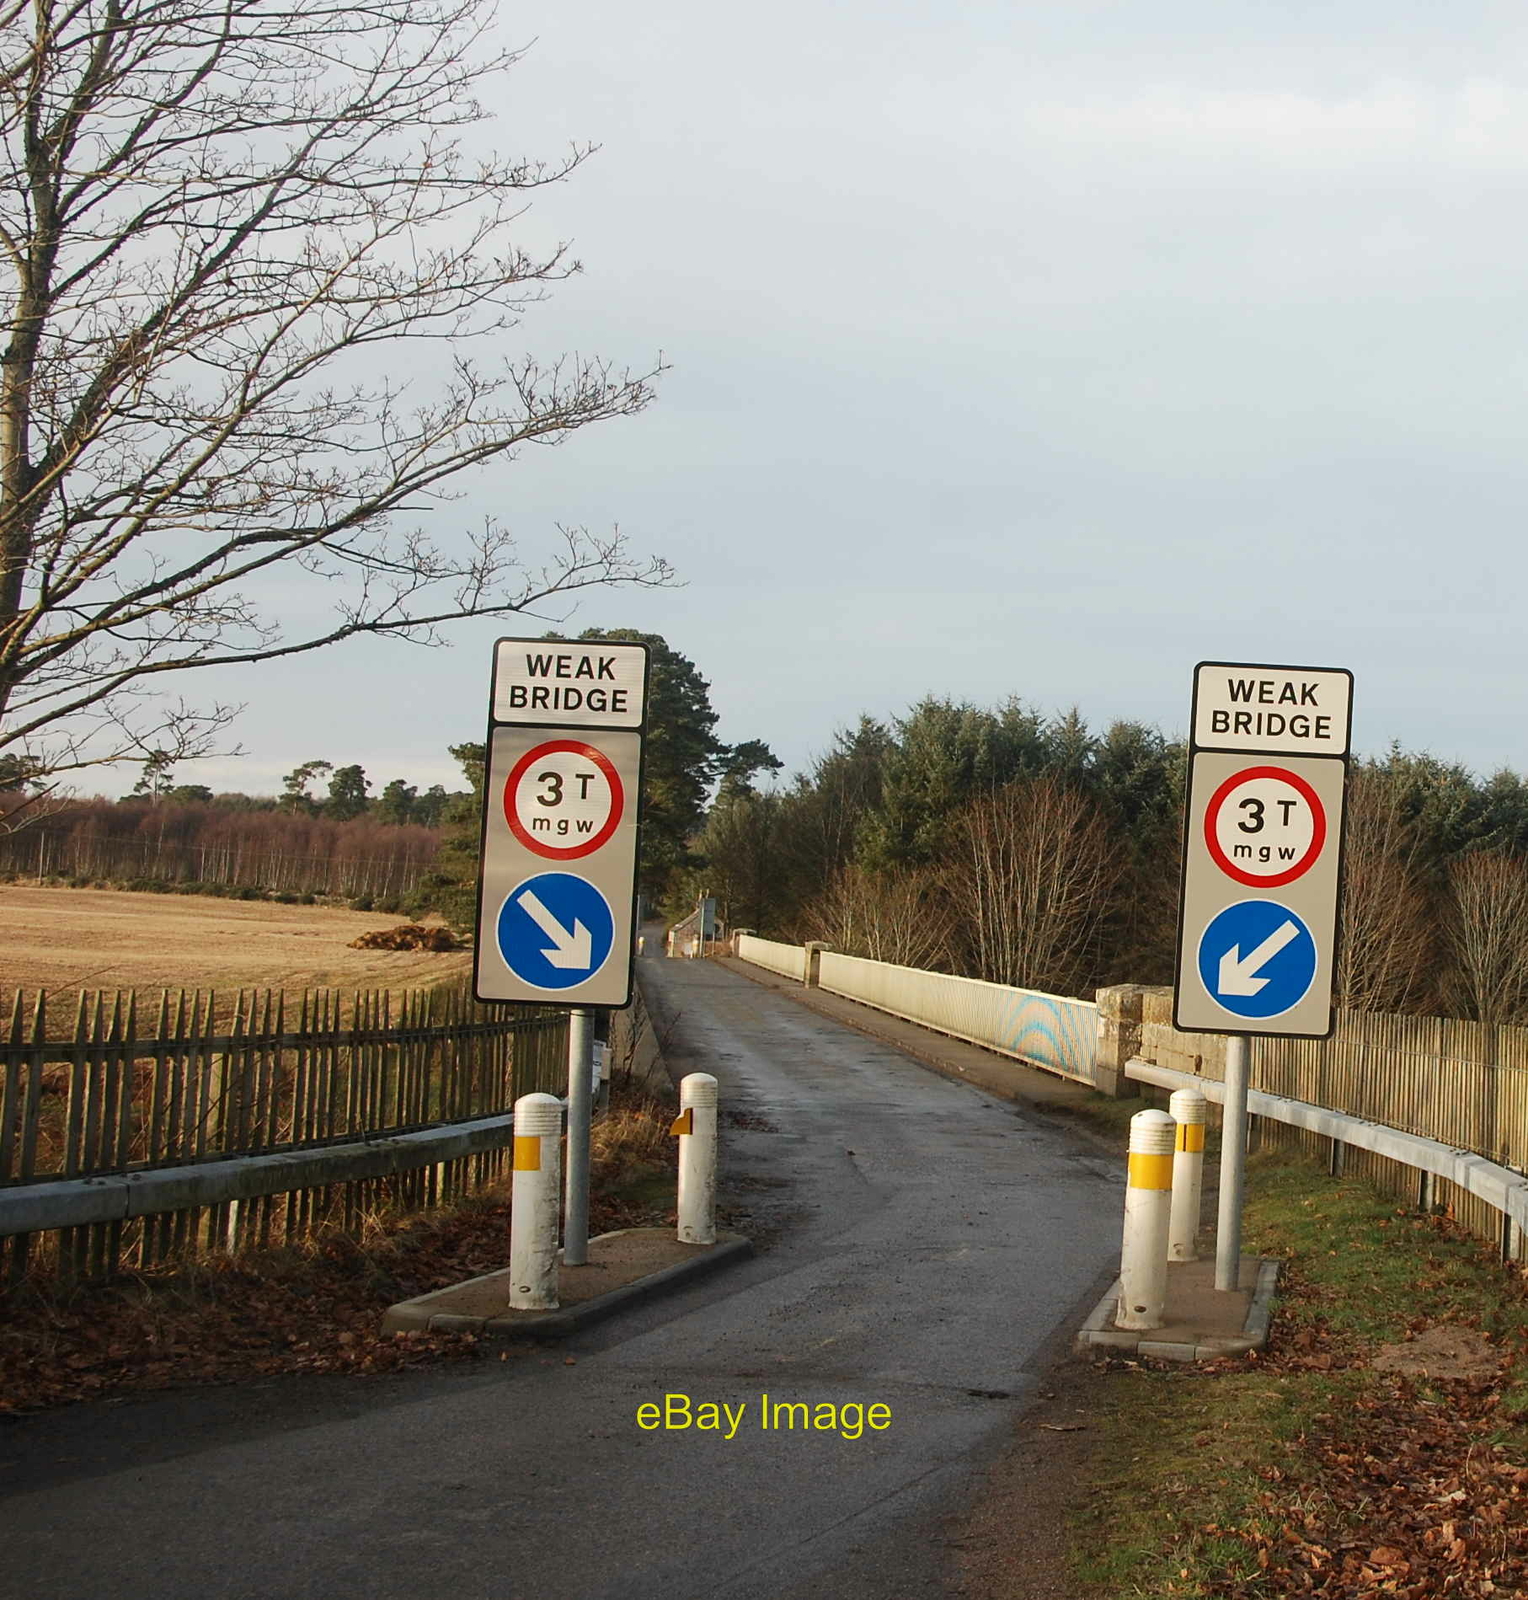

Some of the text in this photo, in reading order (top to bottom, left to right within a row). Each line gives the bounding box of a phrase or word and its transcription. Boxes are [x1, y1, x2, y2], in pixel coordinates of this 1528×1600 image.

[525, 653, 617, 681] WEAK
[509, 685, 628, 713] BRIDGE
[1227, 678, 1319, 707] WEAK
[1211, 709, 1332, 740] BRIDGE
[536, 771, 595, 807] 3 T
[1237, 797, 1297, 834] 3 T
